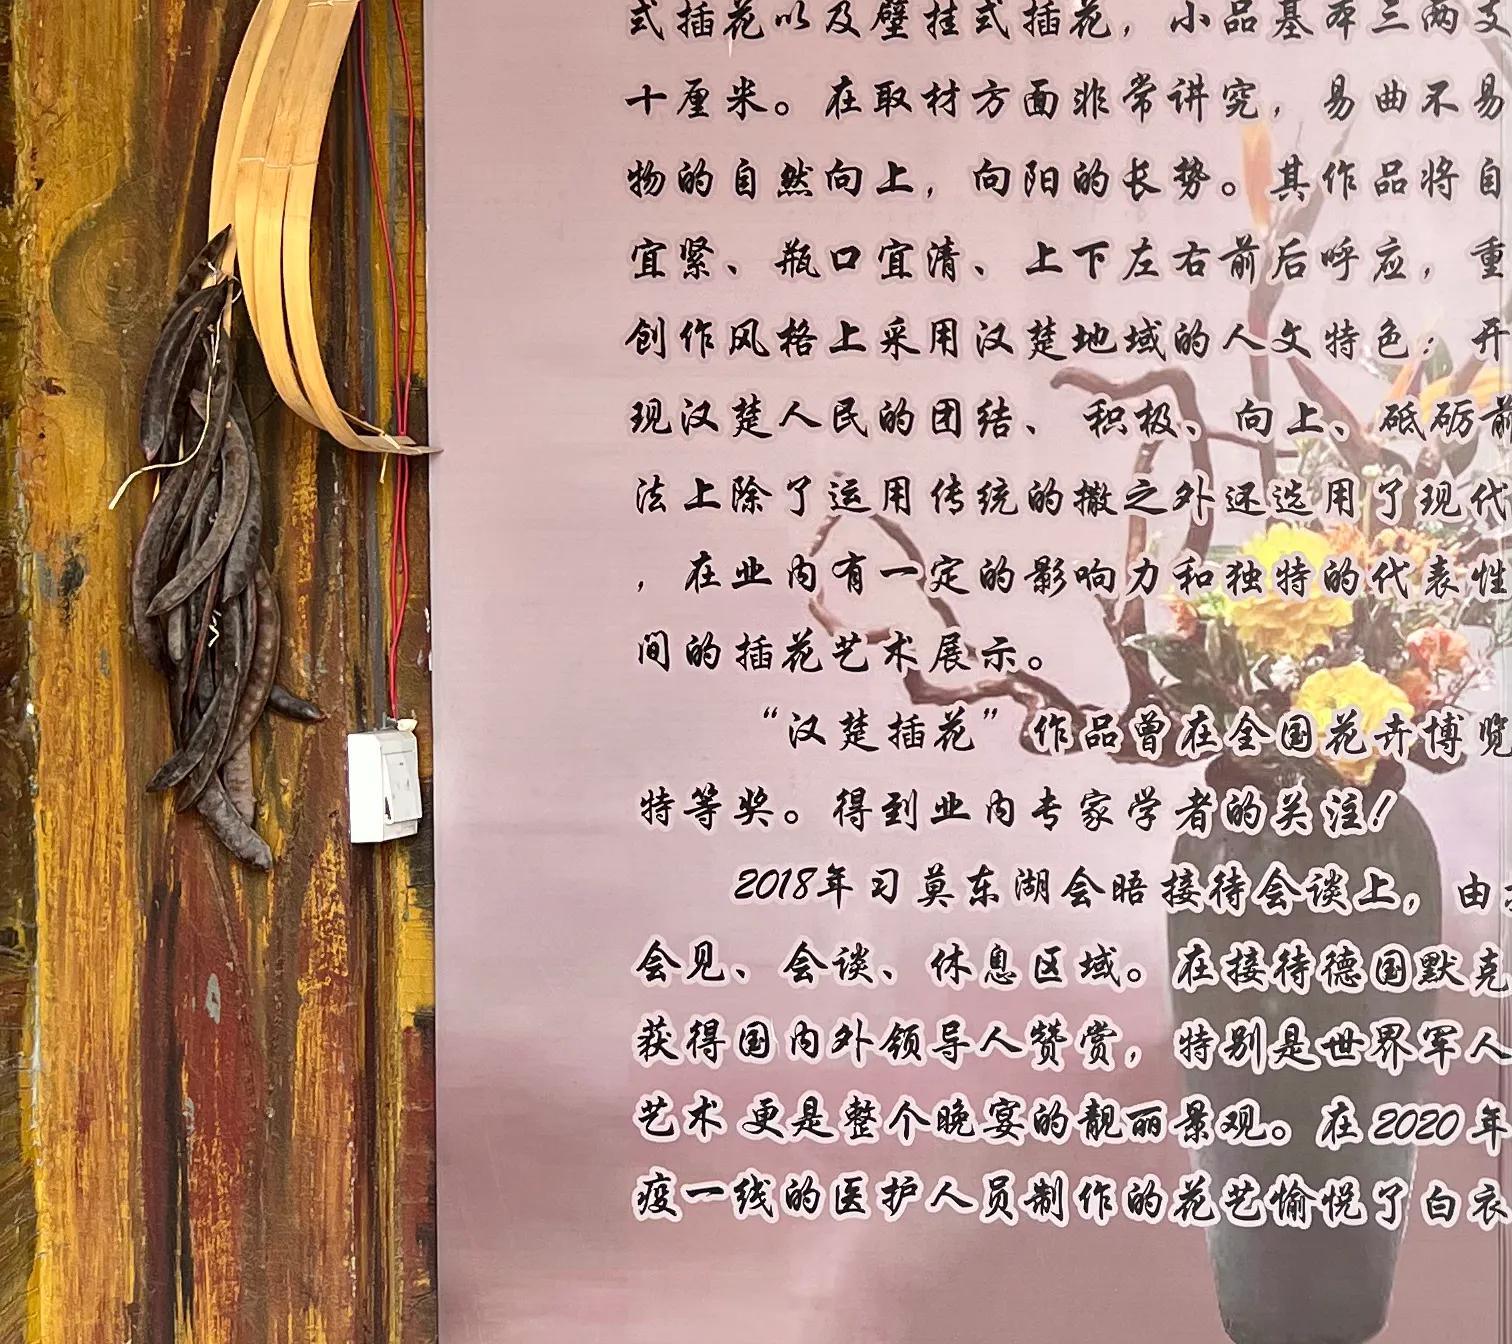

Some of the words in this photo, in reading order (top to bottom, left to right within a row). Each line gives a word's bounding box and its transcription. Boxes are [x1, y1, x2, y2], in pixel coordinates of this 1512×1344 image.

[637, 626, 1043, 674] 间的插花艺术展示。
